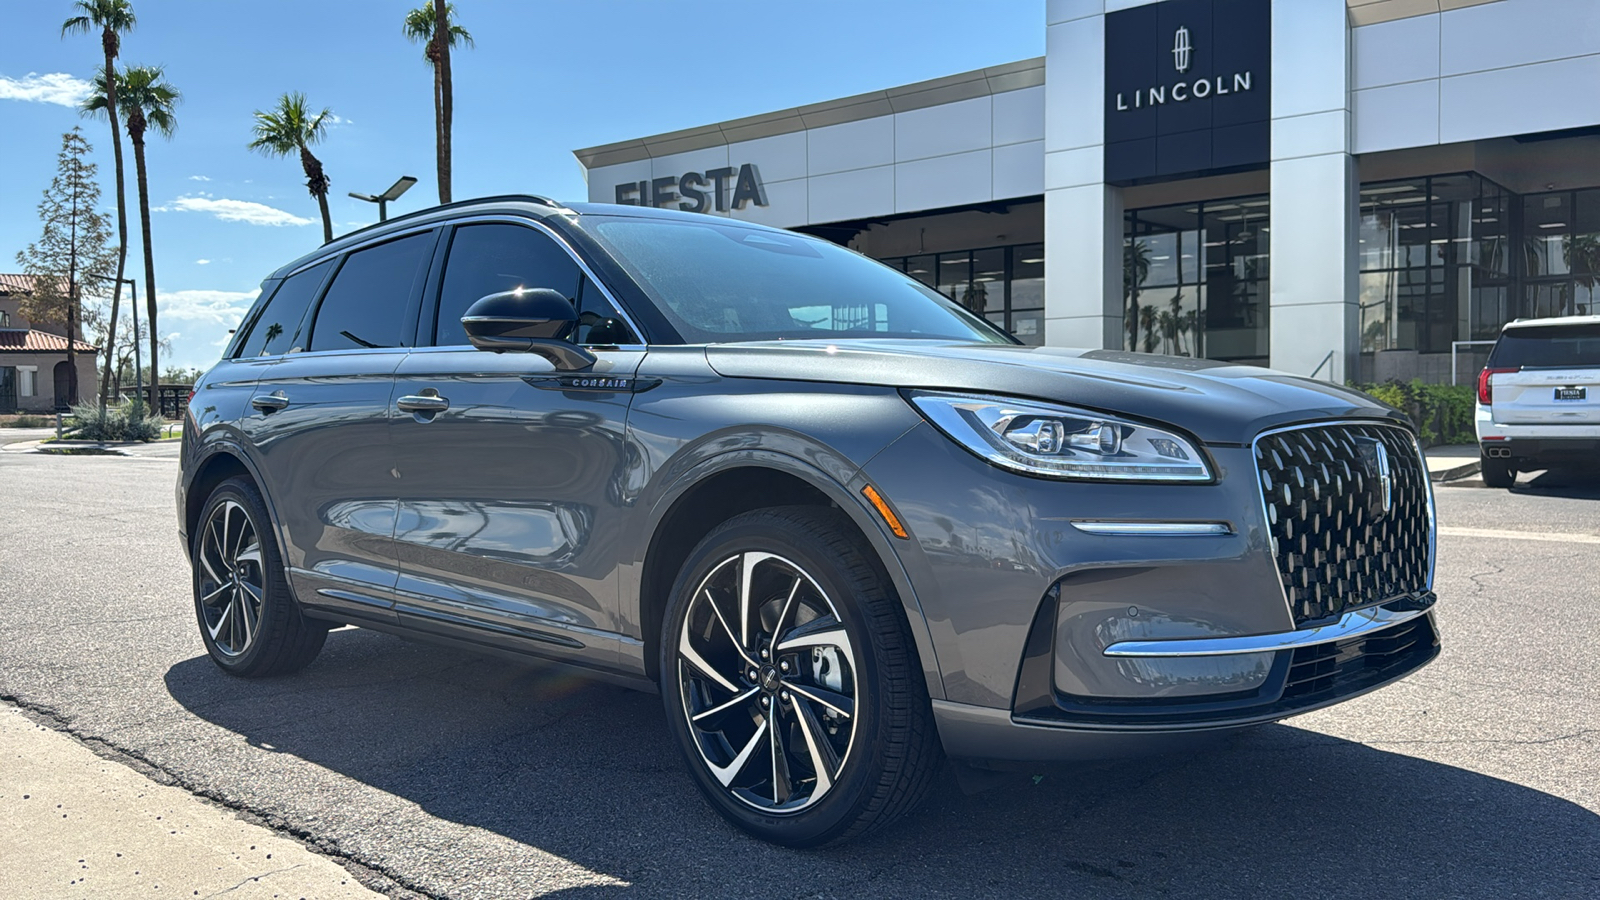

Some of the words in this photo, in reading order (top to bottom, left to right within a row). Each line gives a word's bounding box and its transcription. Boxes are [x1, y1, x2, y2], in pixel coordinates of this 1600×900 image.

[1116, 71, 1251, 111] LINCOLN
[615, 163, 769, 214] FIESTA
[572, 378, 627, 388] CORSAIR
